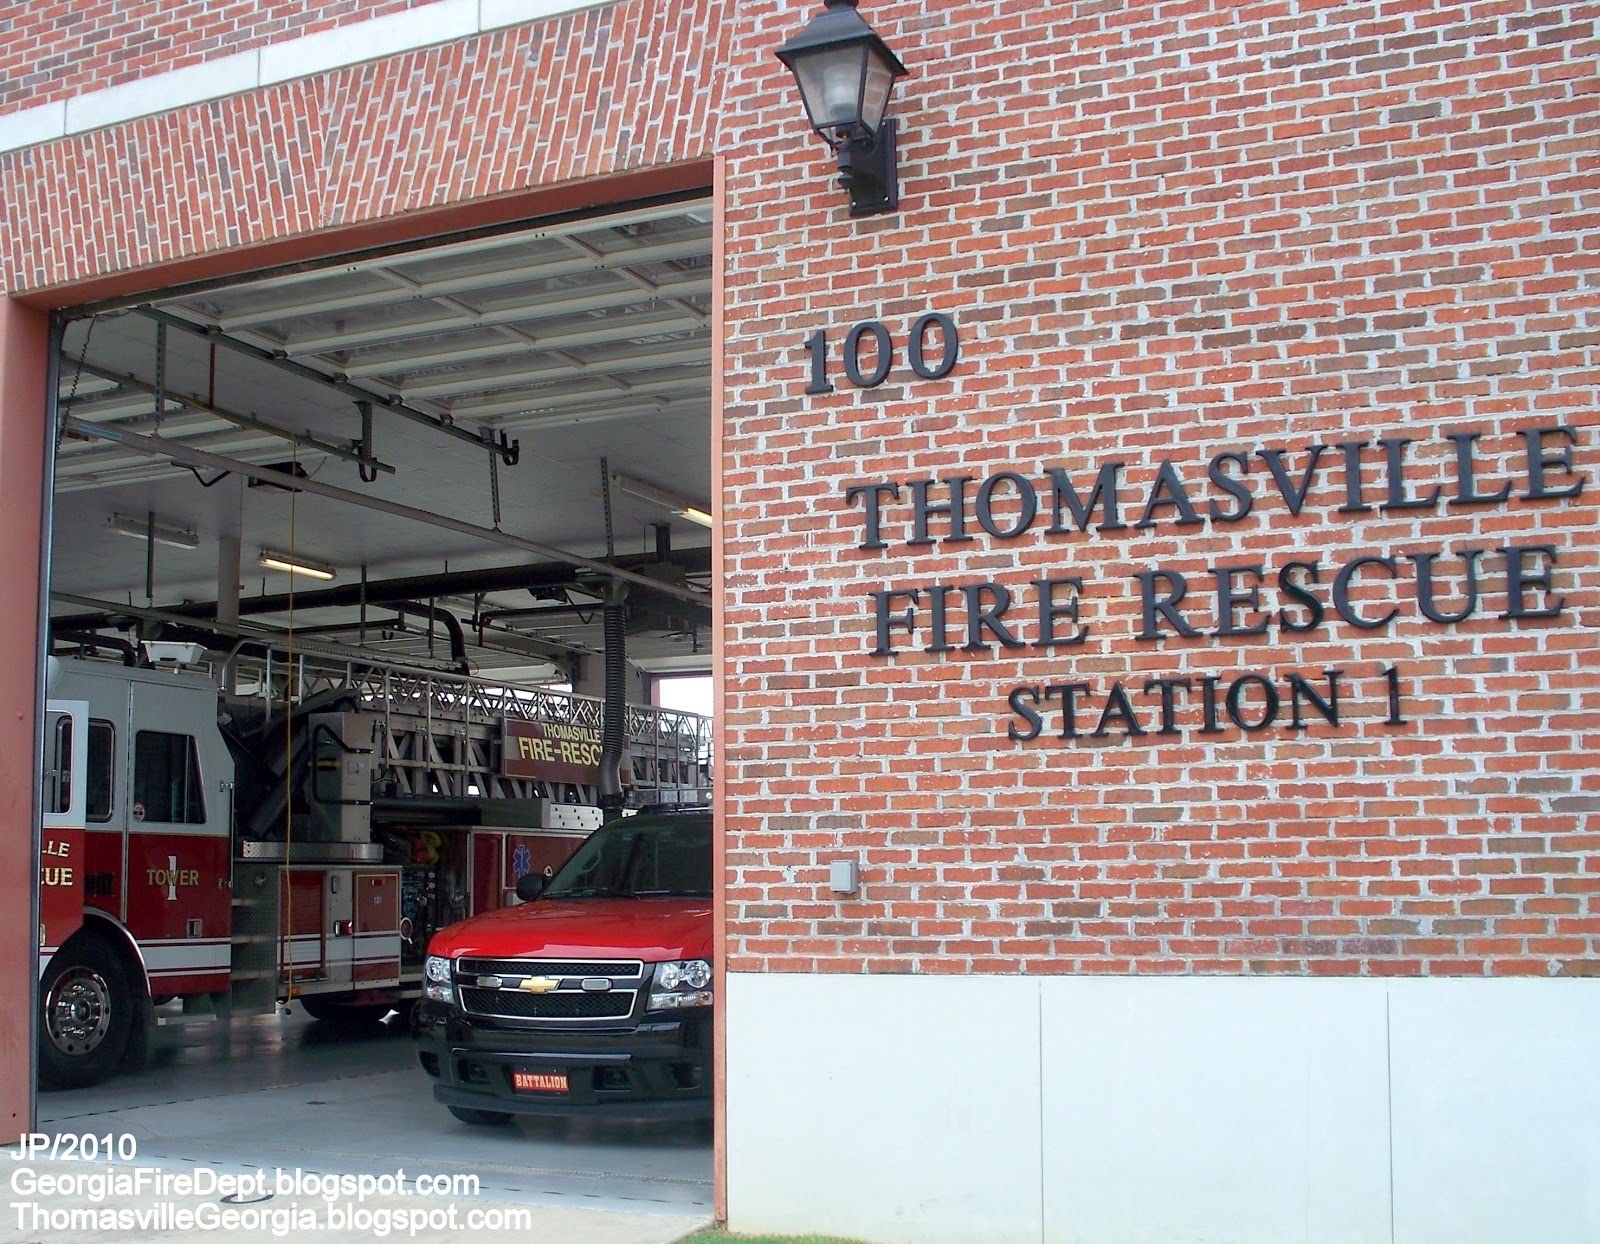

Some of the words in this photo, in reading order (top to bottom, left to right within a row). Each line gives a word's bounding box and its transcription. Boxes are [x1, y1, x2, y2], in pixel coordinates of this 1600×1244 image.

[804, 312, 959, 395] 100
[846, 425, 1586, 549] THOMASVILLE
[868, 576, 1089, 657] FIRE
[1133, 544, 1566, 641] RESCUE
[1008, 669, 1344, 740] STATION
[1382, 666, 1408, 725] 1
[541, 722, 601, 743] THOMASVILLE
[41, 840, 70, 857] LE
[41, 867, 73, 886] UE
[146, 869, 199, 886] TOWER
[515, 1074, 568, 1089] BATTALION
